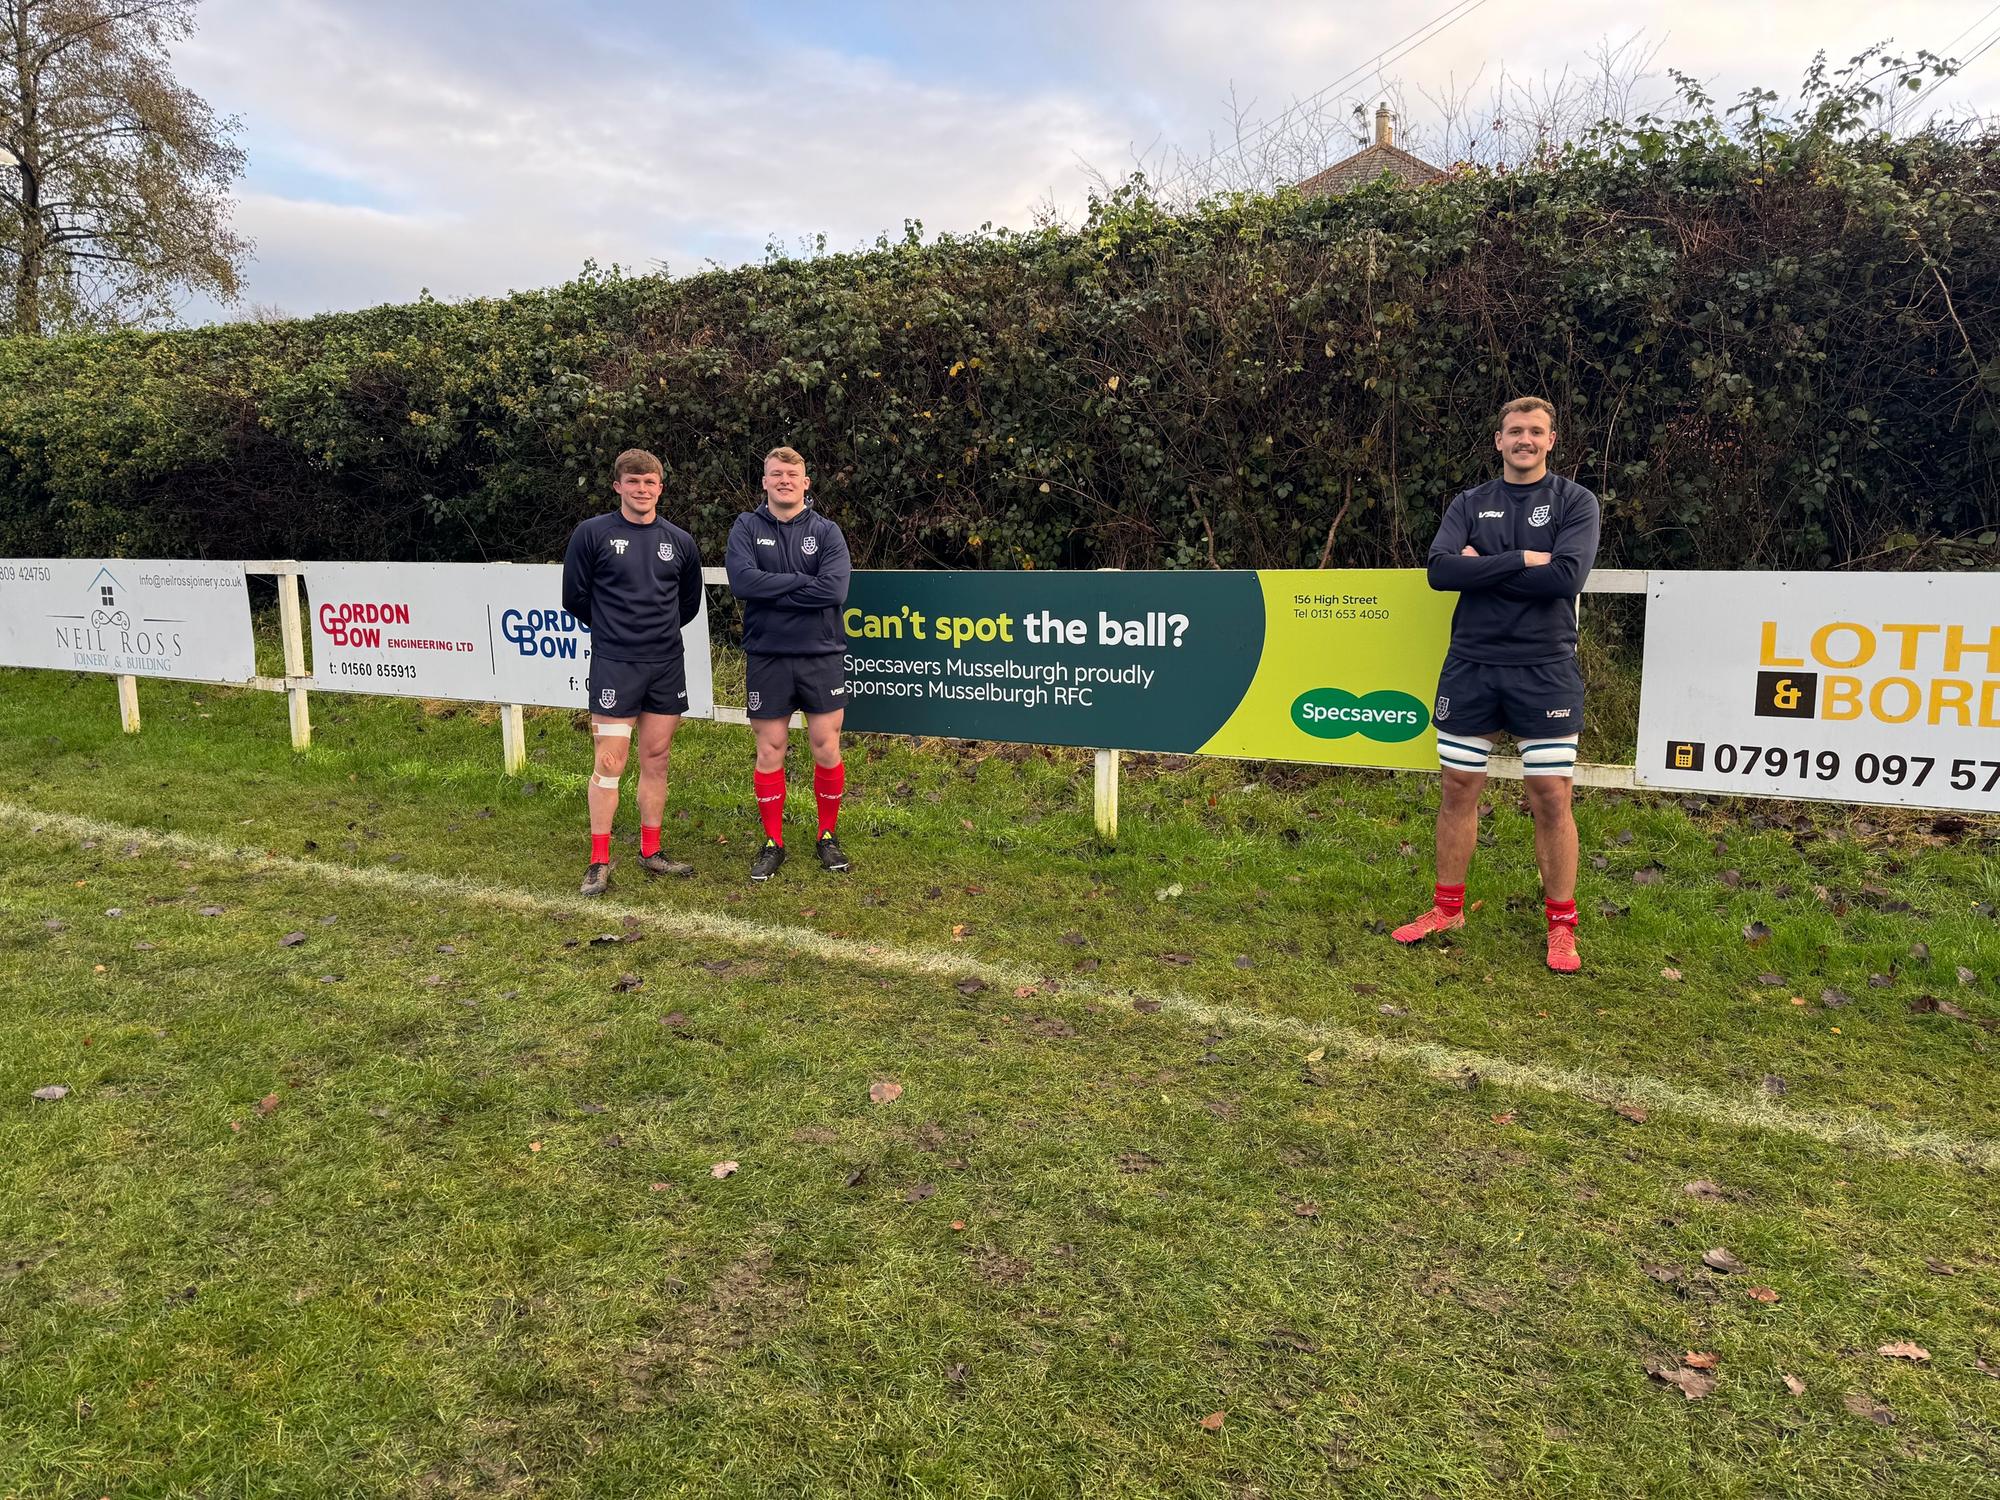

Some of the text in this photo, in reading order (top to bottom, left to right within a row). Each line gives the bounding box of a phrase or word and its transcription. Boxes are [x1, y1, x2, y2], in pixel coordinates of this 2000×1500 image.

[19, 567, 51, 581] 424750
[1294, 595, 1377, 606] 156 High Street
[1294, 609, 1389, 619] Tel 0131 653 4050
[319, 603, 410, 635] GORDON
[502, 609, 592, 643] GORD
[935, 612, 1014, 649] spot
[1023, 610, 1088, 645] the
[1098, 611, 1190, 647] ball?
[56, 626, 182, 656] NEIL ROSS
[329, 617, 474, 652] BOW ENGINEERING LTD
[513, 624, 577, 659] BOW
[1759, 621, 2000, 673] LOTH
[74, 652, 171, 671] JOINERY & BUILDING
[329, 662, 417, 678] t: 01560 855913
[843, 654, 1155, 689] Specsavers Musselburgh proudly
[844, 680, 1093, 707] sponsors Musselburgh RFC
[1773, 679, 1802, 709] &
[1302, 702, 1418, 725] Specsavers
[1546, 708, 1571, 718] VSN
[1714, 743, 2000, 792] 07919 097 57
